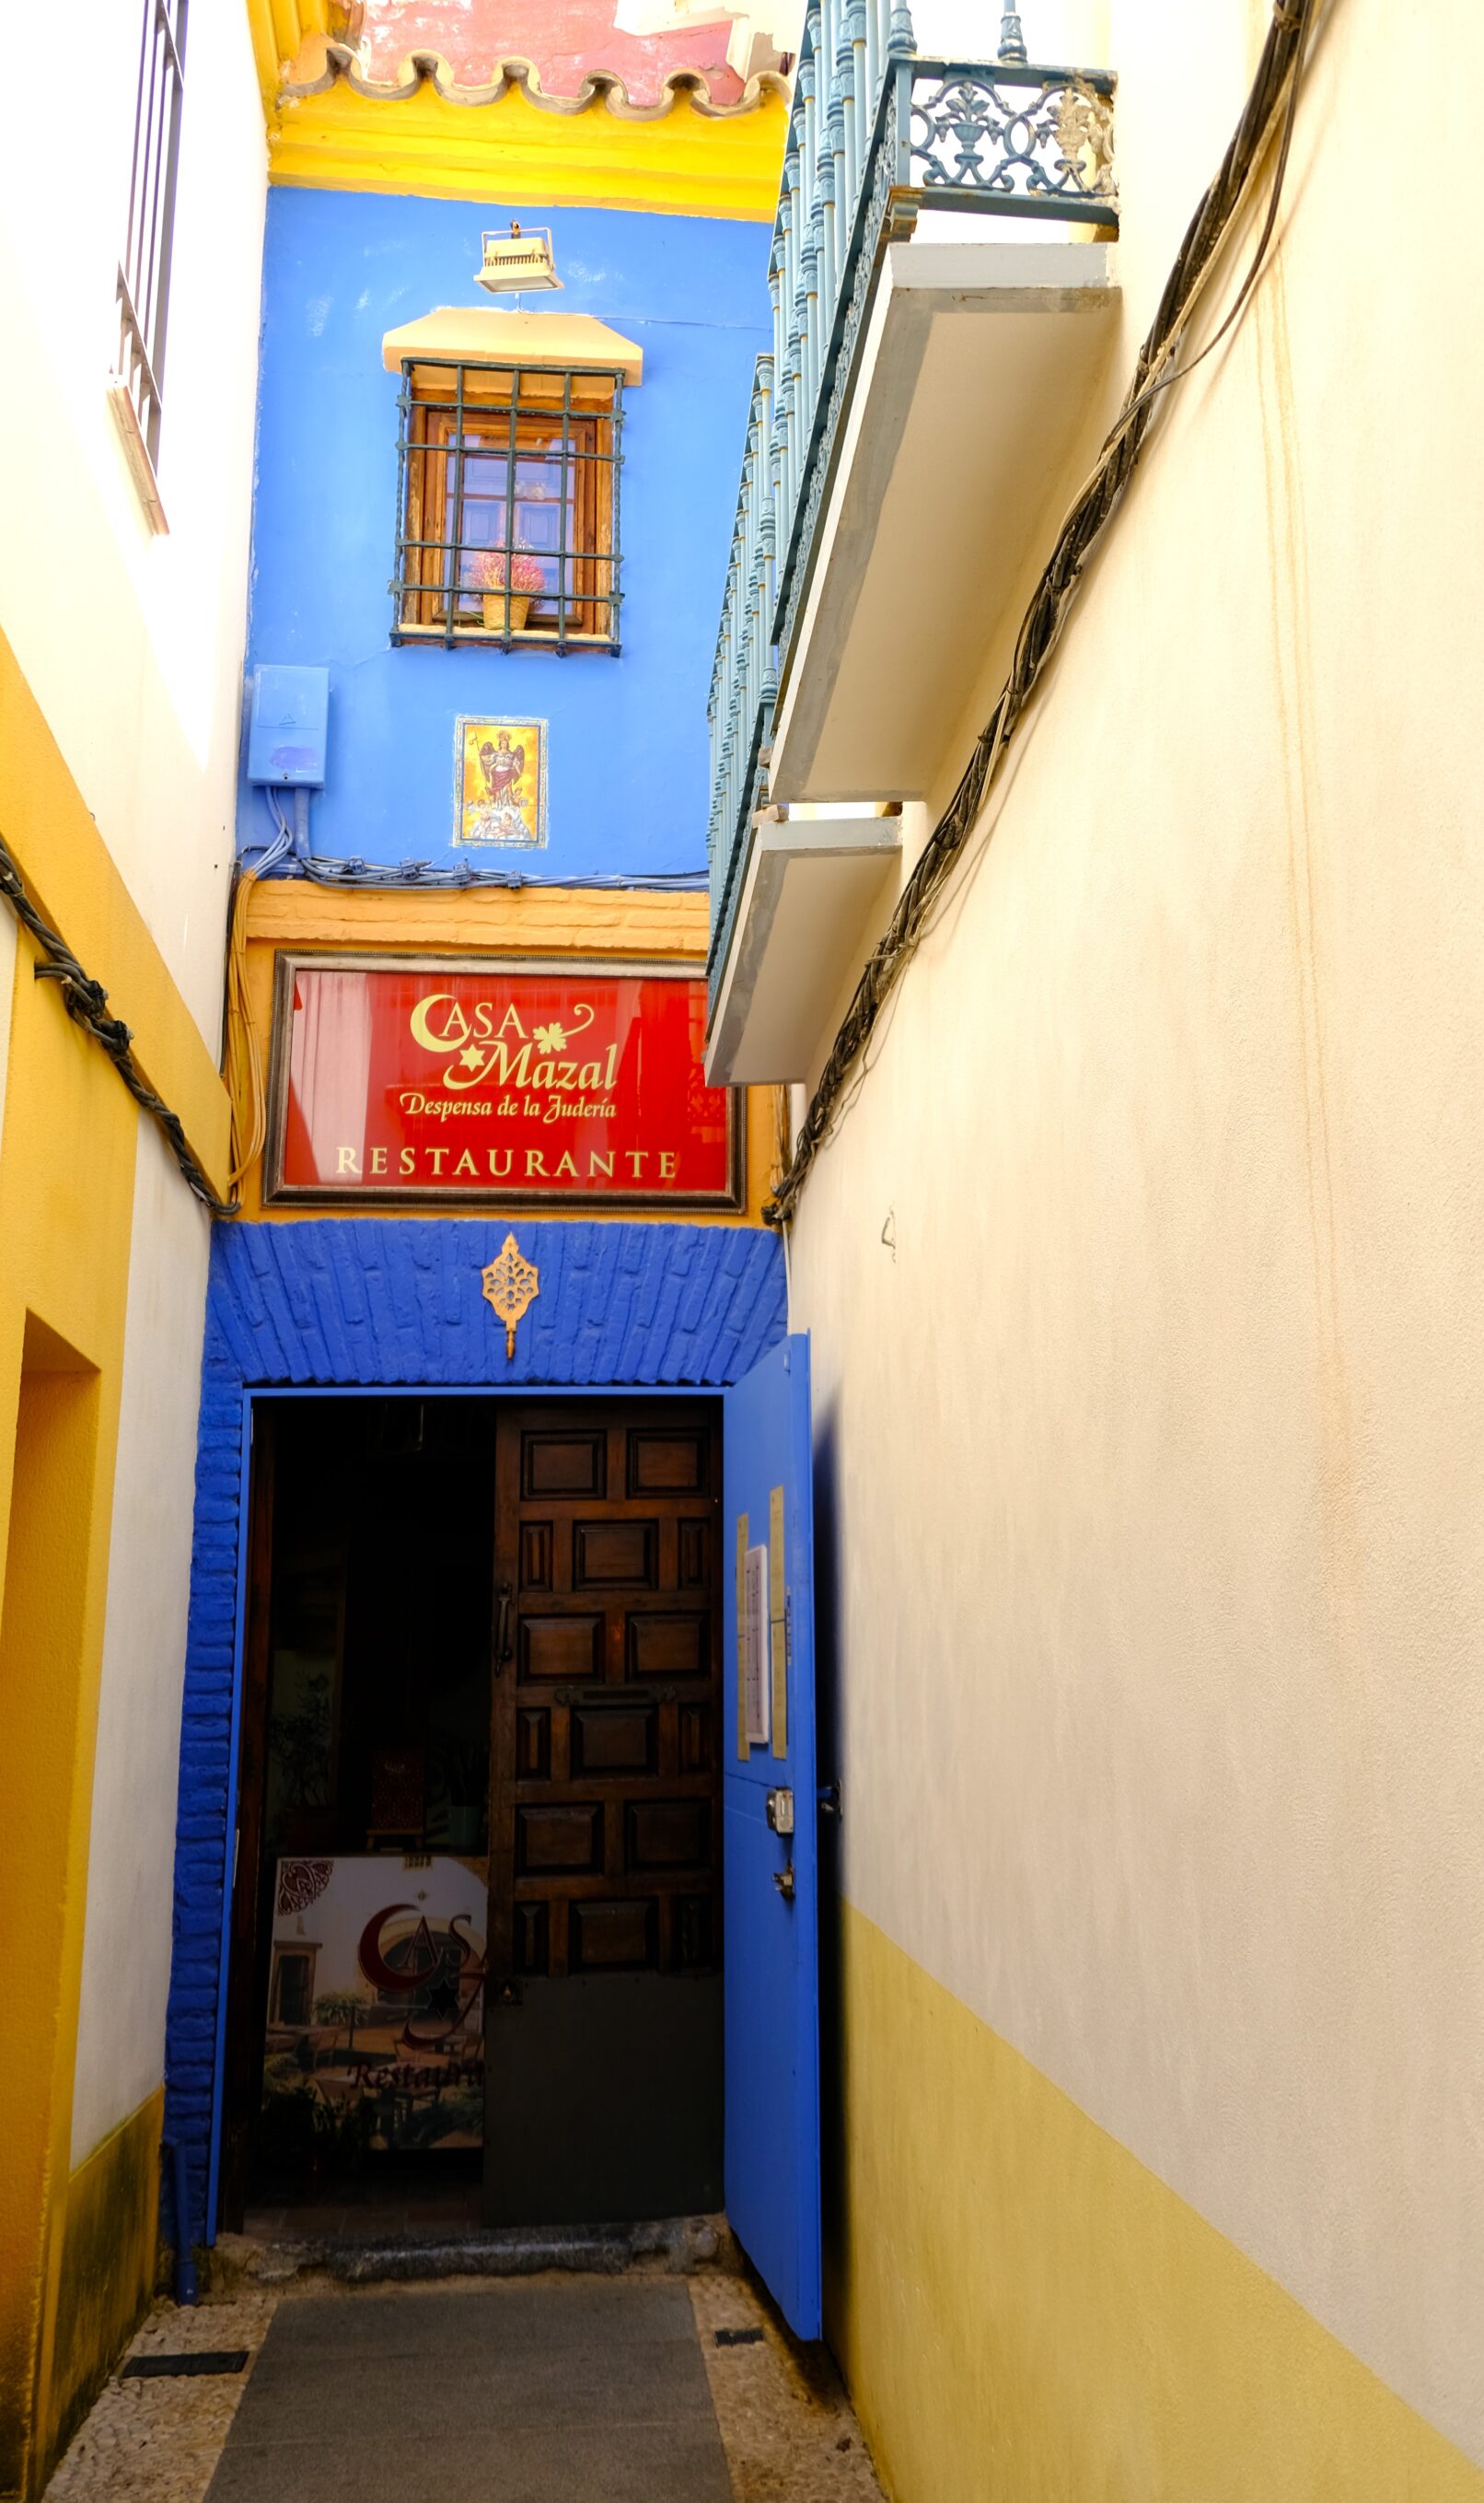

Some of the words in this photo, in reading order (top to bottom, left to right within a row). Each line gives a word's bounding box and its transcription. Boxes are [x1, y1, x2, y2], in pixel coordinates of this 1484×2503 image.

[411, 994, 528, 1053] CASA
[443, 1041, 618, 1090] Mazal
[399, 1092, 493, 1123] Despensa
[497, 1093, 517, 1116] de
[523, 1095, 540, 1116] la
[542, 1094, 617, 1123] Judería
[336, 1147, 678, 1179] RESTAURANTE
